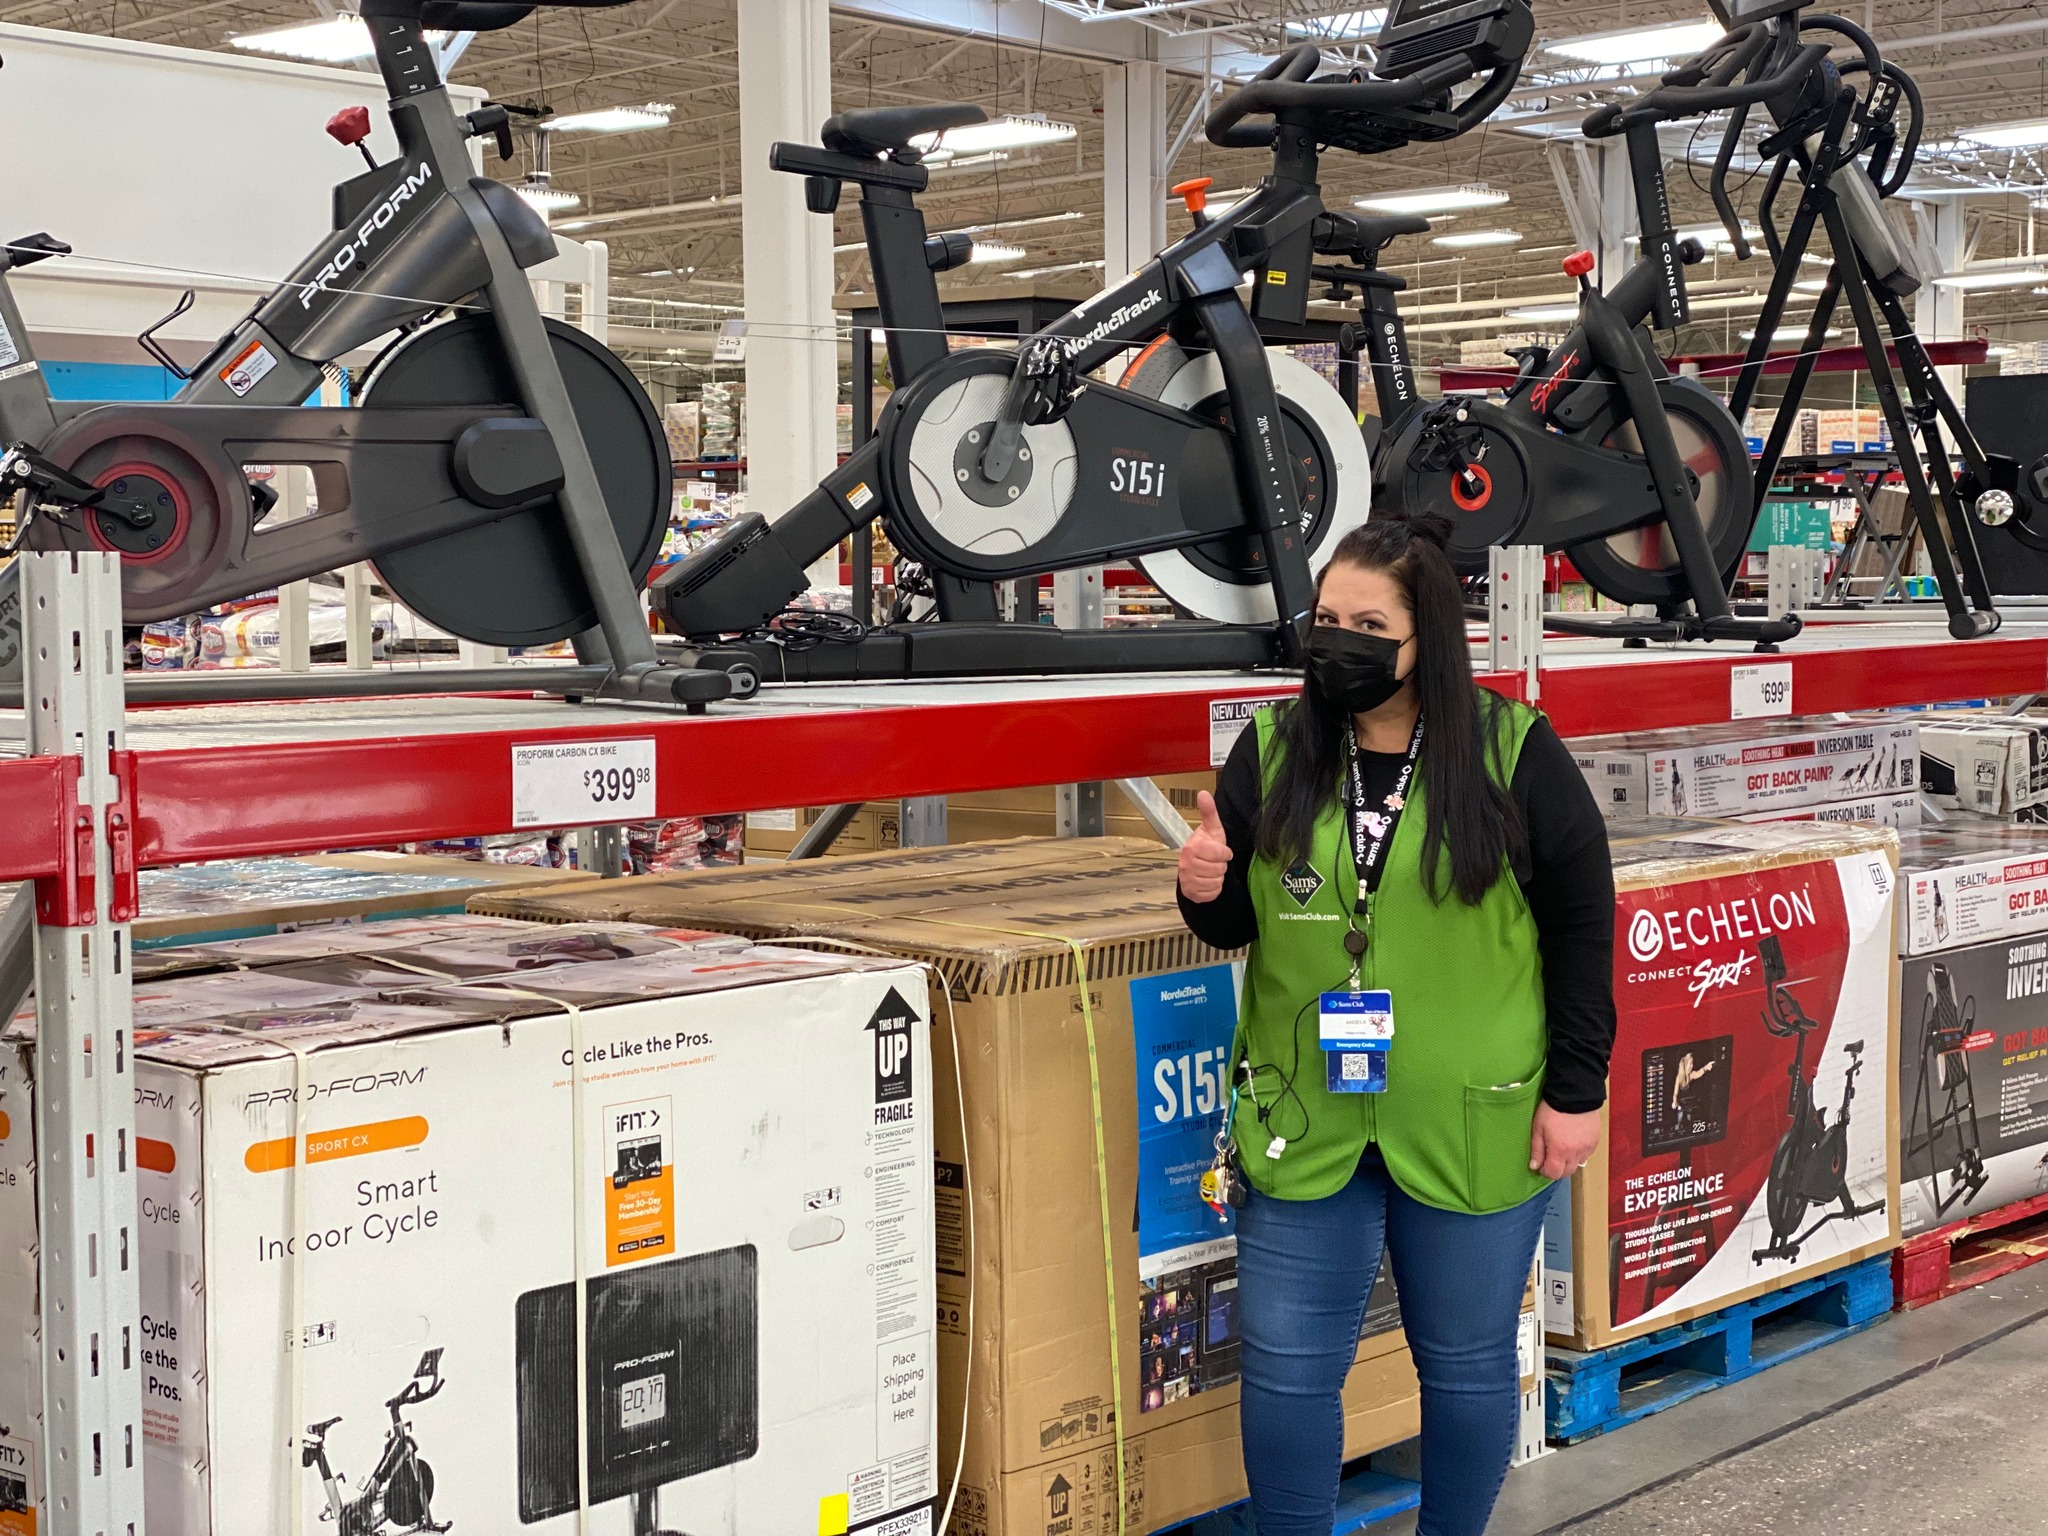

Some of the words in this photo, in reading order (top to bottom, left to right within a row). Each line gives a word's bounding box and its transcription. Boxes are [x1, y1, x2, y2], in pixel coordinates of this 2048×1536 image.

[298, 161, 432, 310] PRO-FORM
[1661, 241, 1681, 319] CONNECT
[1064, 288, 1162, 359] NordicTrack
[1387, 336, 1408, 401] ECHELON
[1110, 457, 1165, 497] S15i
[1212, 704, 1234, 720] NEW
[517, 750, 555, 760] PROFORM
[556, 748, 588, 759] CARBON
[588, 747, 599, 757] CX
[600, 745, 618, 756] BIKE
[1771, 746, 1785, 758] HEAT
[1817, 737, 1854, 755] INVERSION
[1854, 733, 1874, 750] TABLE
[1694, 753, 1726, 769] HEALTH
[1747, 773, 1769, 791] GOT
[1772, 769, 1802, 787] BACK
[1804, 765, 1834, 783] PAIN?
[1855, 803, 1876, 820] TABLE
[1284, 872, 1318, 889] Sam's
[1955, 872, 1987, 888] HEALTH
[2009, 890, 2031, 910] GOT
[2033, 888, 2048, 906] BA
[1664, 888, 1816, 950] ECHELON
[2008, 942, 2047, 965] SOOTHING
[1627, 965, 1692, 983] CONNECT
[2006, 960, 2048, 1001] INVER
[1160, 984, 1207, 1002] NordicTrack
[879, 1018, 892, 1031] THIS
[892, 1016, 906, 1029] WAY
[562, 1047, 606, 1066] Ccle
[611, 1039, 642, 1059] Like
[646, 1036, 671, 1053] the
[676, 1032, 713, 1049] Pros.
[1152, 1038, 1197, 1056] COMMERCIAL
[2003, 1031, 2028, 1053] GOT
[2031, 1026, 2048, 1046] BA
[879, 1033, 908, 1078] UP
[591, 1072, 610, 1081] studio
[611, 1068, 640, 1078] workouts
[641, 1065, 656, 1073] from
[656, 1063, 670, 1072] your
[670, 1060, 688, 1068] home
[244, 1067, 424, 1110] PRO-FORM
[1153, 1046, 1226, 1123] S15i
[616, 1111, 647, 1133] iFIT
[875, 1101, 913, 1126] FRAGILE
[875, 1127, 914, 1141] TECHNOLOGY
[1692, 1121, 1706, 1134] 225
[308, 1137, 349, 1155] SPORT
[351, 1134, 369, 1148] CX
[875, 1160, 916, 1175] ENGINEERING
[1164, 1161, 1196, 1176] Interactive
[1625, 1177, 1645, 1191] THE
[1647, 1166, 1692, 1187] ECHELON
[357, 1169, 438, 1206] Smart
[1624, 1172, 1724, 1213] EXPERIENCE
[142, 1197, 180, 1223] Cycle
[619, 1202, 635, 1211] Free
[635, 1197, 661, 1208] 30-Day
[363, 1205, 438, 1244] Cycle
[875, 1214, 905, 1228] COMFORT
[1625, 1223, 1662, 1239] THOUSANDS
[1663, 1222, 1672, 1231] OF
[1673, 1218, 1685, 1229] LIVE
[1686, 1214, 1699, 1225] AND
[1700, 1205, 1733, 1221] ON-DEMAND
[1624, 1251, 1646, 1264] WORLD
[1647, 1246, 1667, 1258] CLASS
[1667, 1235, 1706, 1253] INSTRUCTORS
[1625, 1236, 1647, 1249] STUDIO
[1648, 1230, 1675, 1243] CLASSES
[875, 1256, 915, 1272] CONFIDENCE
[1624, 1263, 1661, 1280] SUPPORTIVE
[1662, 1253, 1697, 1270] COMMUNITY
[140, 1314, 177, 1341] Cycle
[155, 1348, 178, 1371] the
[613, 1349, 675, 1371] PRO-FORM
[892, 1352, 916, 1367] Place
[149, 1375, 182, 1402] Pros.
[883, 1367, 924, 1389] Shipping
[891, 1385, 916, 1405] Label
[893, 1407, 915, 1423] Here
[1053, 1492, 1067, 1515] UP
